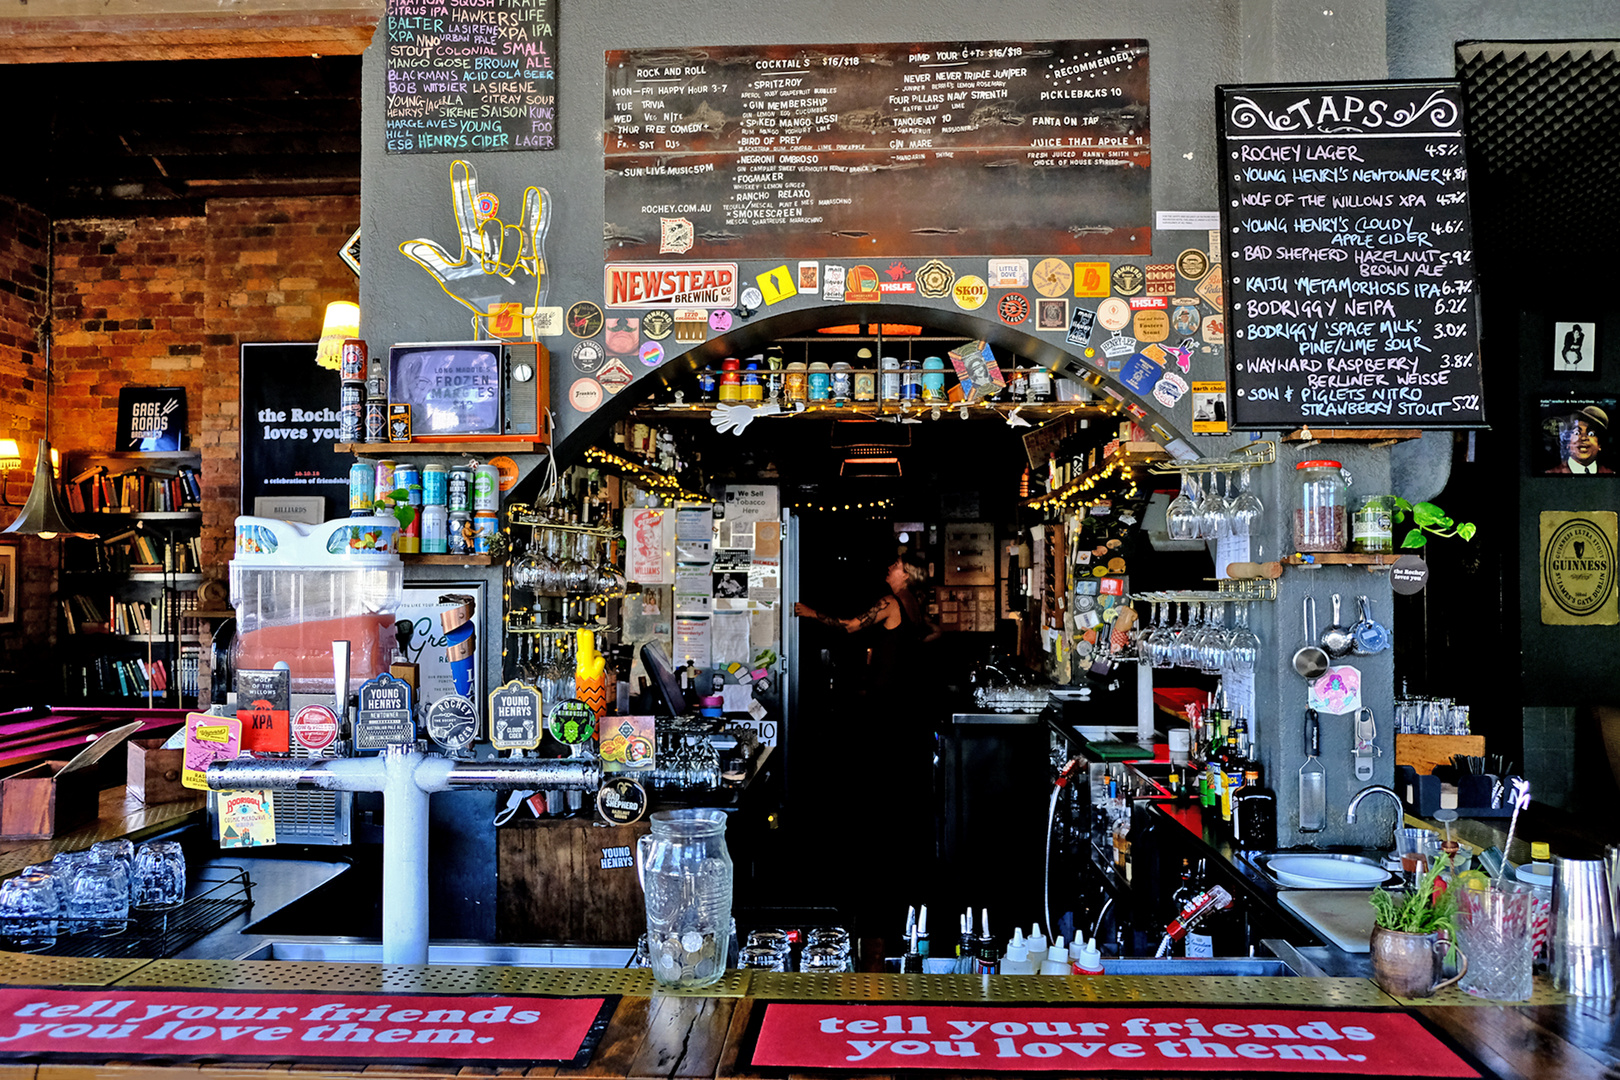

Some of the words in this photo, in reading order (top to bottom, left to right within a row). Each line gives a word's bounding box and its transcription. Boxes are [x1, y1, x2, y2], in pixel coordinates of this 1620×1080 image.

[431, 7, 448, 16] IPA
[518, 10, 545, 22] LIFE
[452, 9, 519, 27] HAWKERS
[388, 17, 444, 33] BALTER
[532, 24, 552, 37] IPA
[389, 30, 414, 42] XPA
[498, 27, 528, 41] XPA
[391, 46, 433, 59] STOUT
[436, 47, 497, 56] COLONIAL
[502, 42, 546, 56] SMALL
[909, 54, 930, 63] PIMP
[936, 51, 958, 60] YOUR
[387, 58, 430, 69] MANGO
[433, 58, 471, 69] GOSE
[475, 58, 519, 70] BROWN
[526, 58, 552, 69] ALE
[388, 70, 458, 81] BLACKMANS
[463, 71, 488, 81] ACID
[524, 70, 554, 79] BEER
[637, 68, 660, 78] ROCK
[664, 68, 681, 76] AND
[685, 66, 706, 75] ROLL
[904, 74, 931, 83] NEVER
[936, 72, 961, 81] NEVER
[389, 82, 417, 94] BOB
[658, 86, 684, 95] HAPPY
[1041, 88, 1108, 100] PICKLEBACKS
[1110, 88, 1122, 96] 10
[525, 95, 554, 104] SOUR
[749, 101, 764, 109] GIN
[768, 98, 828, 110] MEMBERSHIP
[912, 94, 944, 103] PILLARS
[616, 102, 633, 111] TUE
[642, 100, 664, 109] TRIVIA
[942, 114, 951, 123] 10
[1287, 96, 1388, 129] TAPS
[460, 120, 502, 133] YOUNG
[746, 118, 775, 127] SPIKED
[779, 119, 811, 127] MANGO
[1032, 117, 1061, 126] FANTA
[1063, 117, 1077, 126] ON
[418, 133, 467, 148] HENRYS
[471, 134, 508, 147] CIDER
[516, 134, 554, 146] LAGER
[741, 137, 760, 145] BIRD
[763, 137, 775, 145] OF
[780, 136, 801, 144] PREY
[1031, 138, 1061, 147] JUICE
[1069, 138, 1093, 146] THAT
[1098, 137, 1128, 146] APPLE
[1241, 145, 1301, 162] ROCHEY
[1307, 146, 1365, 162] LAGER
[1425, 144, 1458, 158] 4.5%
[738, 172, 784, 183] FOGMAKER
[1242, 169, 1286, 183] YOUNG
[1293, 167, 1348, 183] HENRY'S
[1352, 169, 1446, 186] NEWTOWNER
[736, 192, 769, 201] RANCHO
[778, 189, 810, 198] RELAXO
[1241, 194, 1272, 206] WOLF
[1275, 195, 1294, 206] OF
[1297, 195, 1326, 207] THE
[1332, 195, 1394, 208] WILLOWS
[1399, 195, 1426, 207] XPA
[642, 205, 712, 214] ROCHEY.COM.AU
[733, 208, 802, 219] SMOKESCREEN
[1242, 218, 1287, 233] YOUNG
[1294, 217, 1349, 233] HENRY'S
[1355, 217, 1414, 235] CLOUDY
[1430, 221, 1463, 235] 4.6%
[1331, 234, 1374, 248] APPLE
[1378, 232, 1432, 247] CIDER
[1244, 246, 1272, 262] BAD
[1276, 248, 1348, 262] SHEPHERD
[1355, 250, 1442, 264] HAZELNUT
[1360, 264, 1409, 277] BROWN
[1415, 264, 1447, 277] ALE
[611, 269, 732, 304] NEWSTEAD
[956, 286, 986, 296] SKOL
[1415, 283, 1441, 298] IPA
[1442, 280, 1473, 296] 6.7%
[675, 289, 718, 303] BREWING
[1247, 299, 1336, 318] BODRIGGY
[1344, 300, 1396, 317] NEIPA
[1434, 298, 1467, 315] 6.2%
[1247, 323, 1318, 341] BODRIGGY
[1433, 323, 1467, 340] 3.0%
[1384, 336, 1432, 353] SOUR
[1327, 356, 1418, 374] RASPBERRY
[1440, 352, 1473, 368] 3.8%
[1307, 374, 1389, 389] BERLINER
[1397, 370, 1450, 385] WEISSE
[1301, 388, 1366, 402] PIGLETS
[1372, 388, 1423, 400] NITRO
[133, 403, 160, 416] GAGE
[258, 408, 286, 422] the
[291, 408, 341, 422] Roche
[1398, 402, 1452, 416] STOUT
[132, 416, 168, 430] ROADS
[264, 425, 308, 439] loves
[312, 428, 341, 443] you
[735, 497, 765, 505] Tobacco
[634, 567, 660, 575] WILLIAMS
[1553, 560, 1607, 571] GUINNESS
[371, 689, 399, 699] YOUNG
[368, 699, 401, 709] HENRYS
[501, 696, 530, 706] YOUNG
[438, 700, 472, 715] ROCHEY
[499, 707, 531, 717] HENRYS
[252, 715, 273, 729] XPA
[759, 723, 775, 738] 10
[606, 800, 638, 810] SHEPHERD
[602, 847, 630, 858] YOUNG
[601, 857, 634, 869] HENRYS
[13, 1000, 136, 1017] tell
[125, 1004, 298, 1023] your
[300, 1003, 541, 1025] friends
[0, 1023, 140, 1042] you
[142, 1020, 293, 1041] love
[819, 1015, 932, 1035] tell
[946, 1019, 1110, 1040] your
[1122, 1018, 1376, 1042] friends
[846, 1039, 981, 1062] you
[994, 1038, 1148, 1059] love
